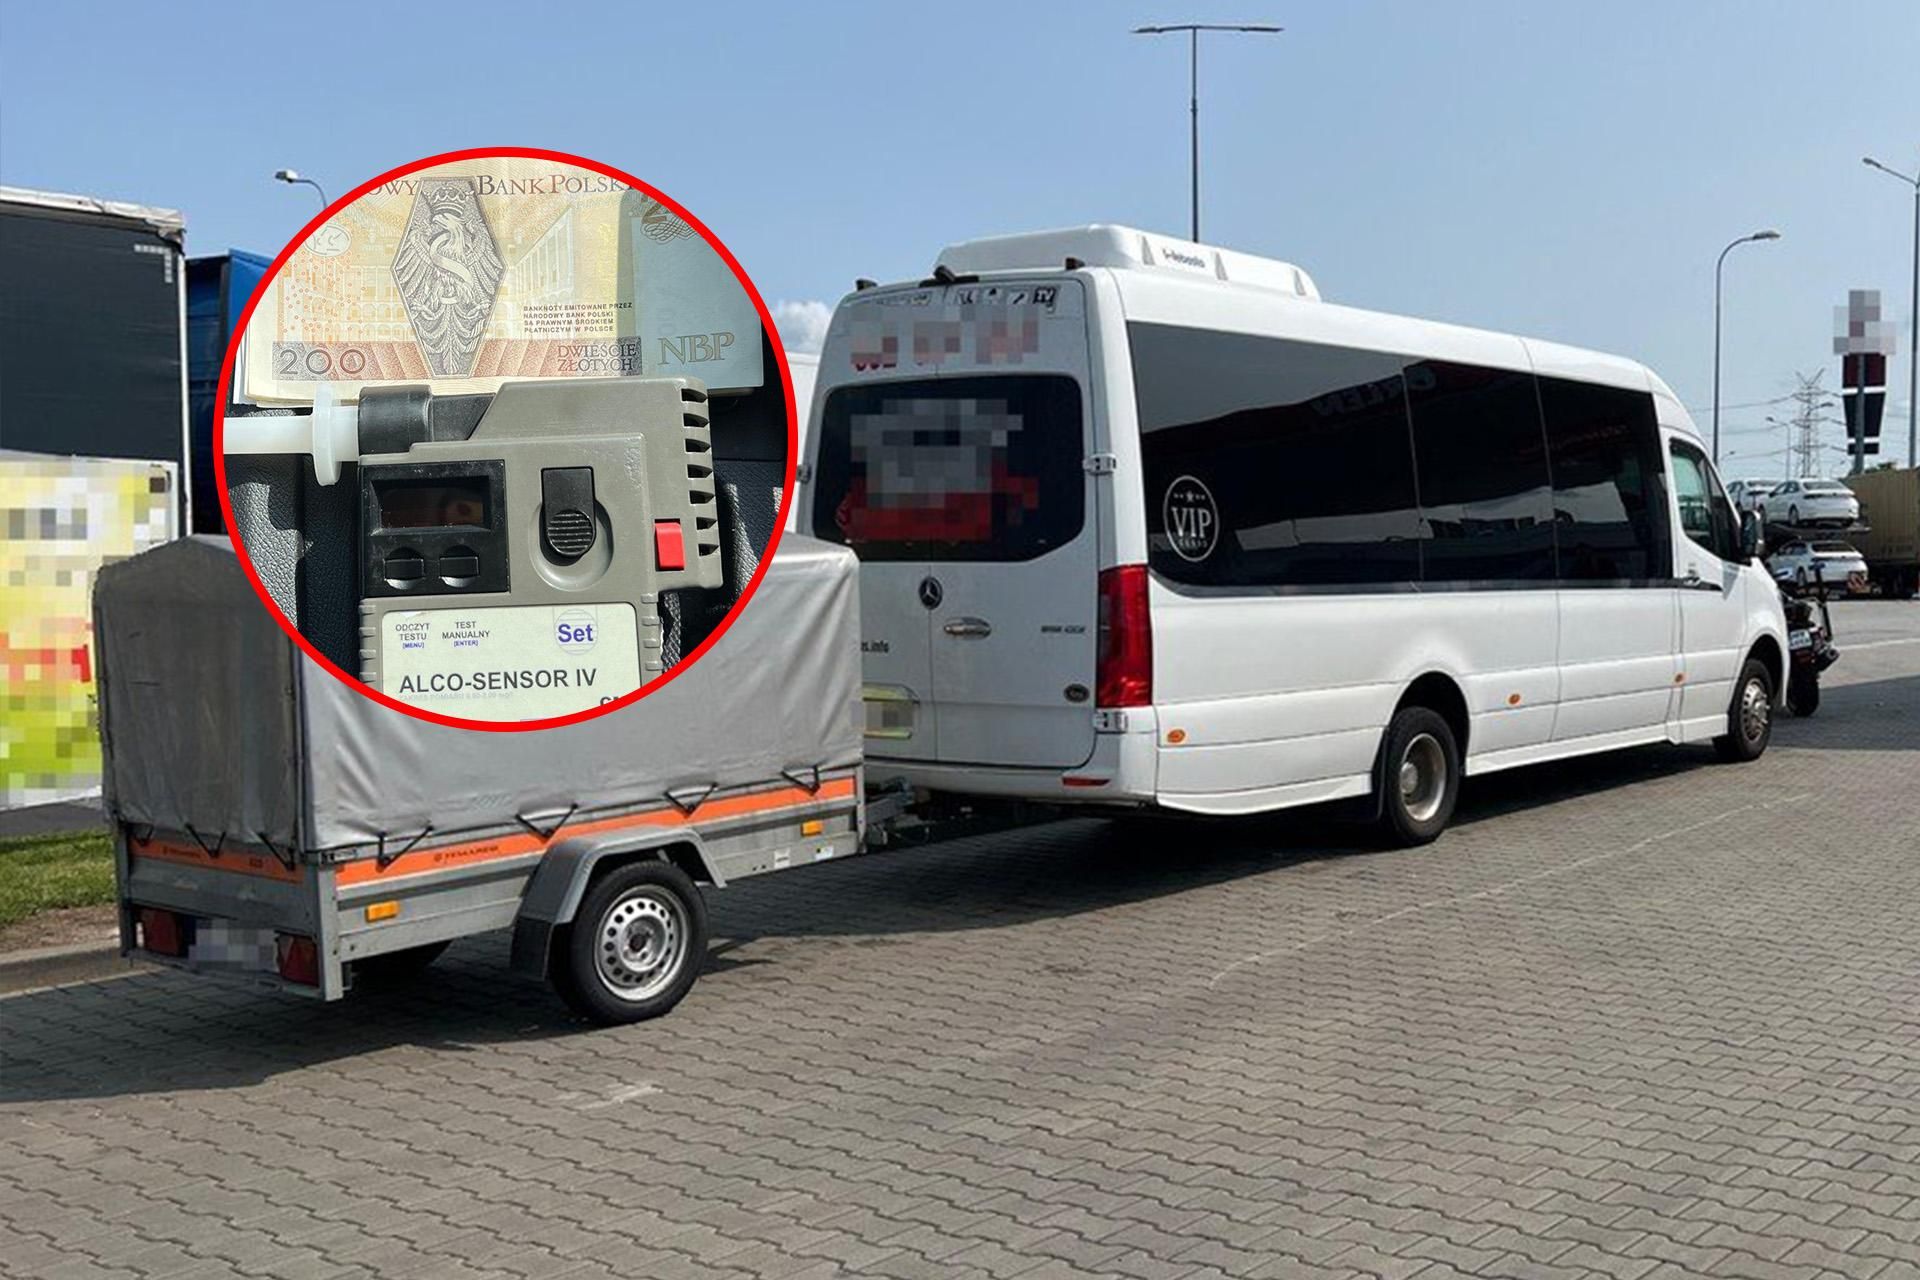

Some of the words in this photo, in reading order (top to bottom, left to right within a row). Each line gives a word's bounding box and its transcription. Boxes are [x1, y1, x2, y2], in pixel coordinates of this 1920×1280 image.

[476, 175, 544, 195] BANK
[557, 342, 637, 358] DWIEŚCIE
[657, 332, 735, 365] NBP
[280, 349, 366, 375] 200
[557, 358, 633, 372] ZŁOTYCH
[1171, 506, 1212, 538] VIP
[395, 622, 430, 631] ODCZYT
[455, 621, 477, 629] TEST
[558, 623, 594, 642] Set
[399, 633, 427, 641] TESTU
[441, 630, 490, 639] MANUALNY
[399, 669, 569, 693] ALCO-SENSOR
[576, 668, 597, 687] IV
